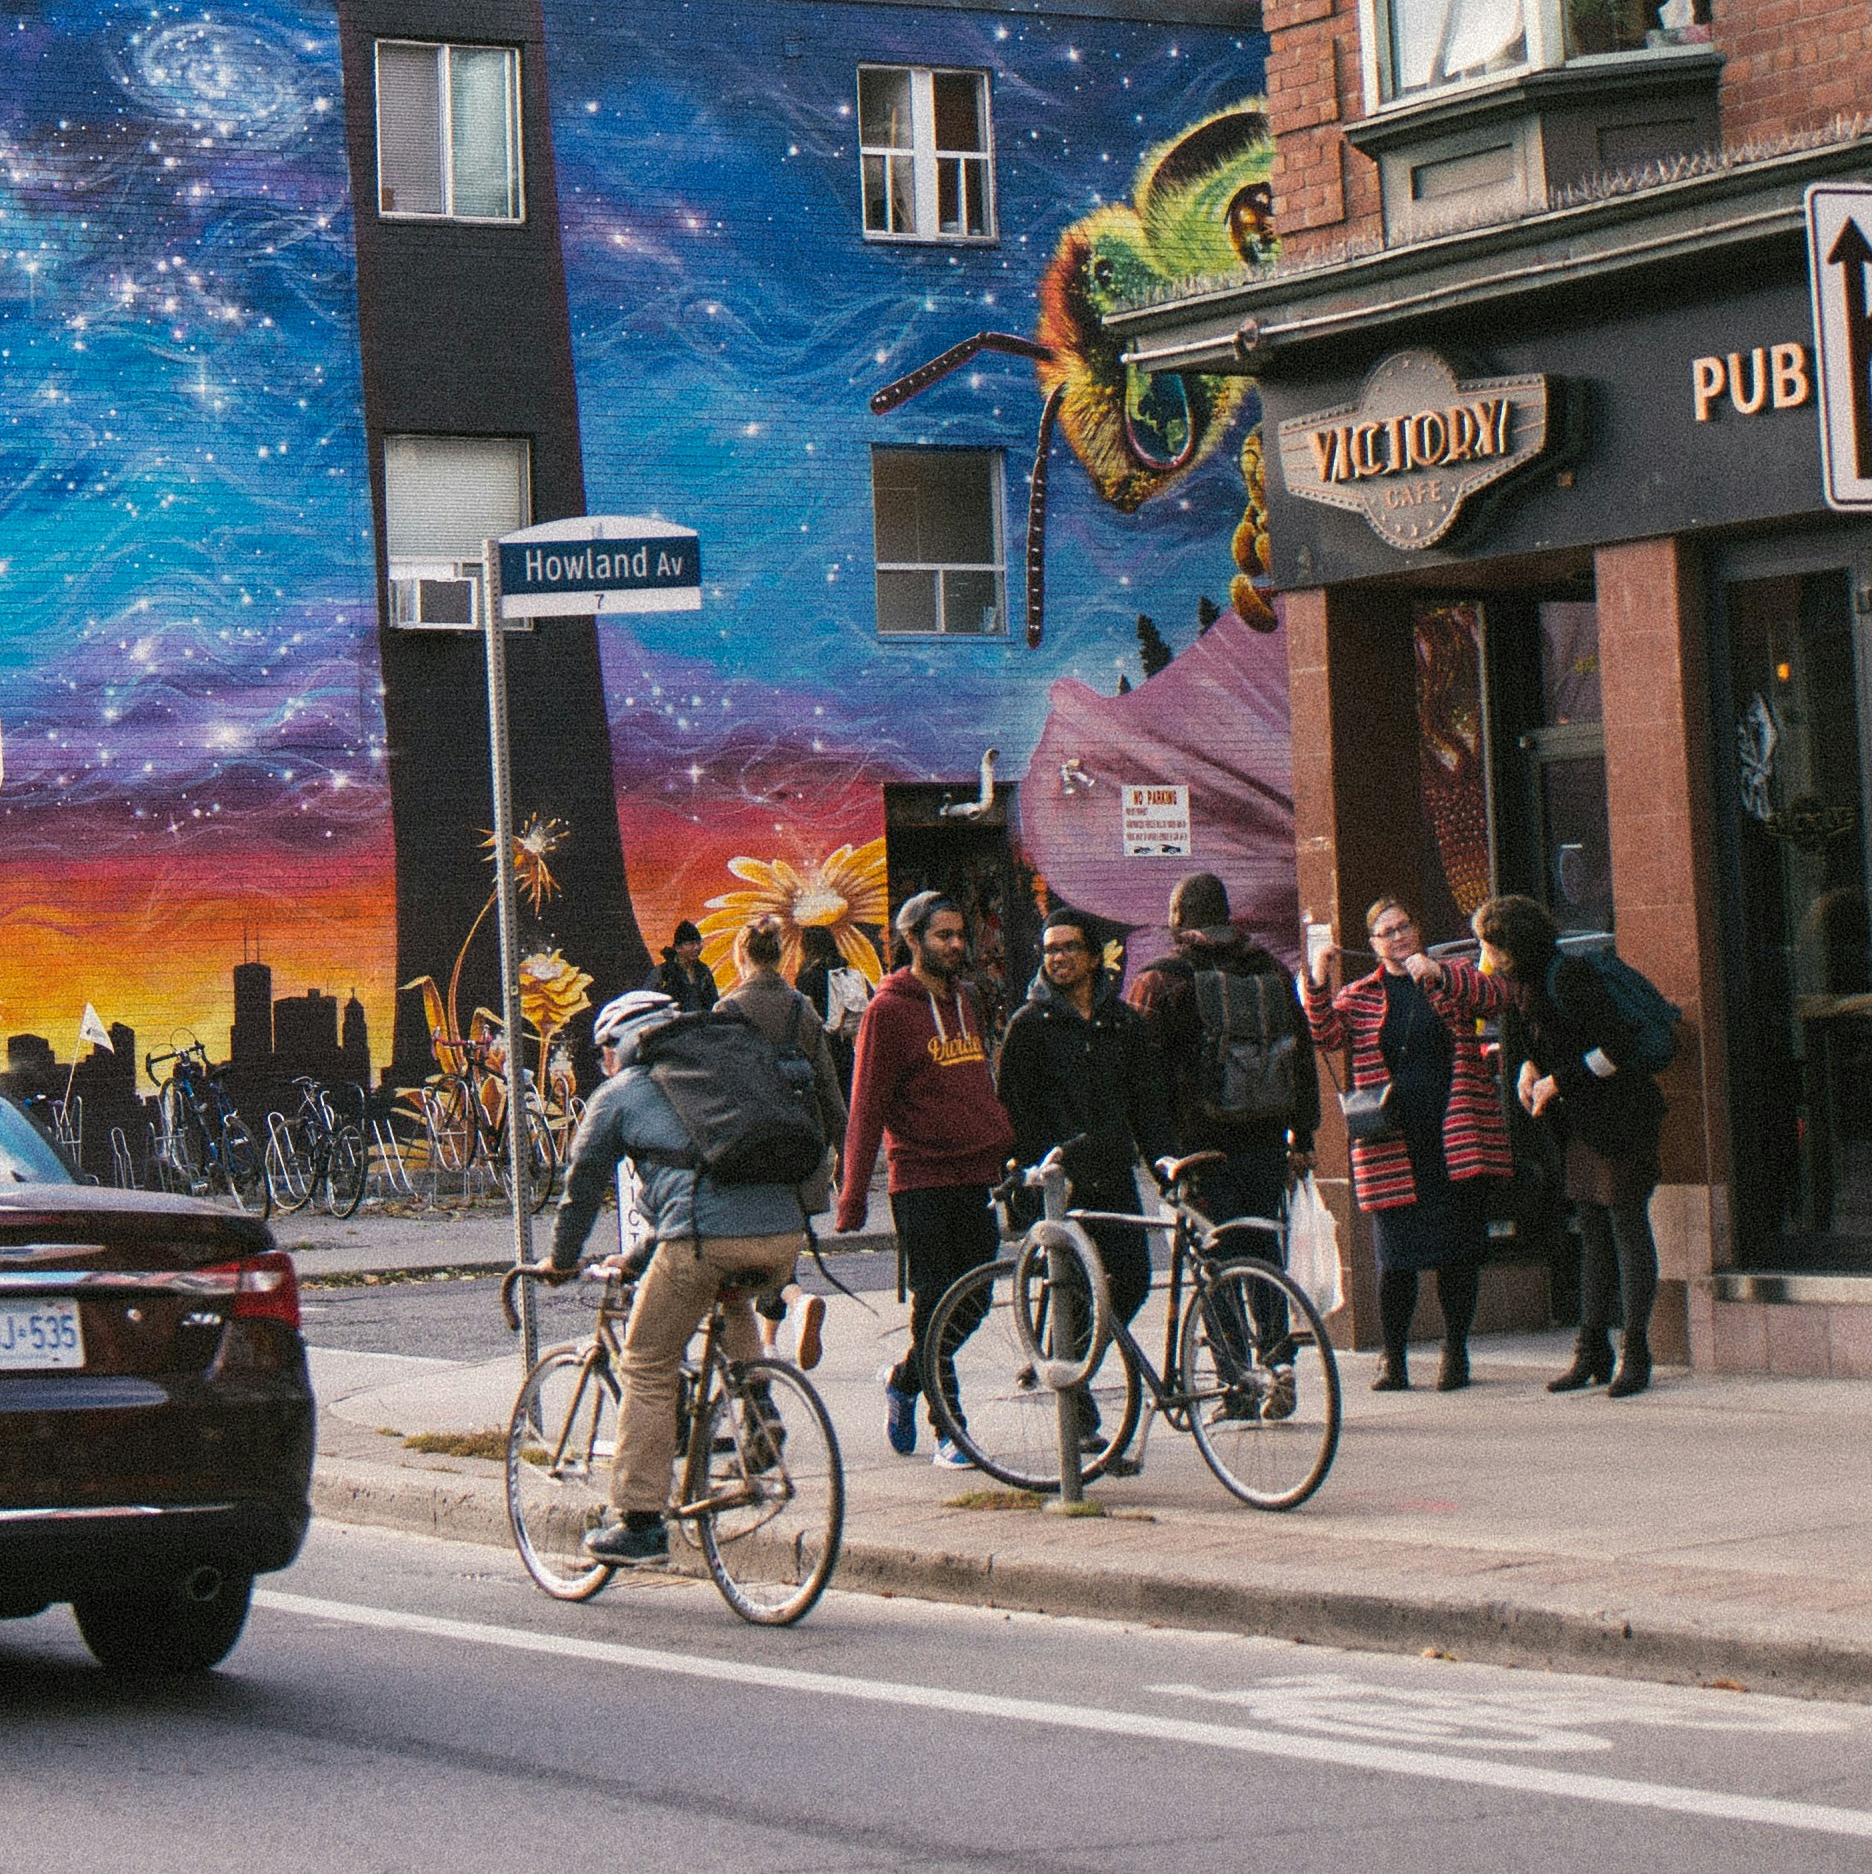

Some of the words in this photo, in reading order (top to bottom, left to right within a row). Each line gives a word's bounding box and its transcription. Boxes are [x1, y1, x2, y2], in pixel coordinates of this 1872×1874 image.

[1692, 341, 1811, 422] PUB
[1309, 398, 1513, 484] VICTORY
[1384, 479, 1442, 510] CAFE
[525, 546, 648, 582] Howland
[656, 551, 684, 577] Av
[593, 593, 605, 610] 7
[1133, 790, 1143, 806] NO
[1147, 790, 1178, 806] PARKING
[30, 1314, 78, 1350] 535
